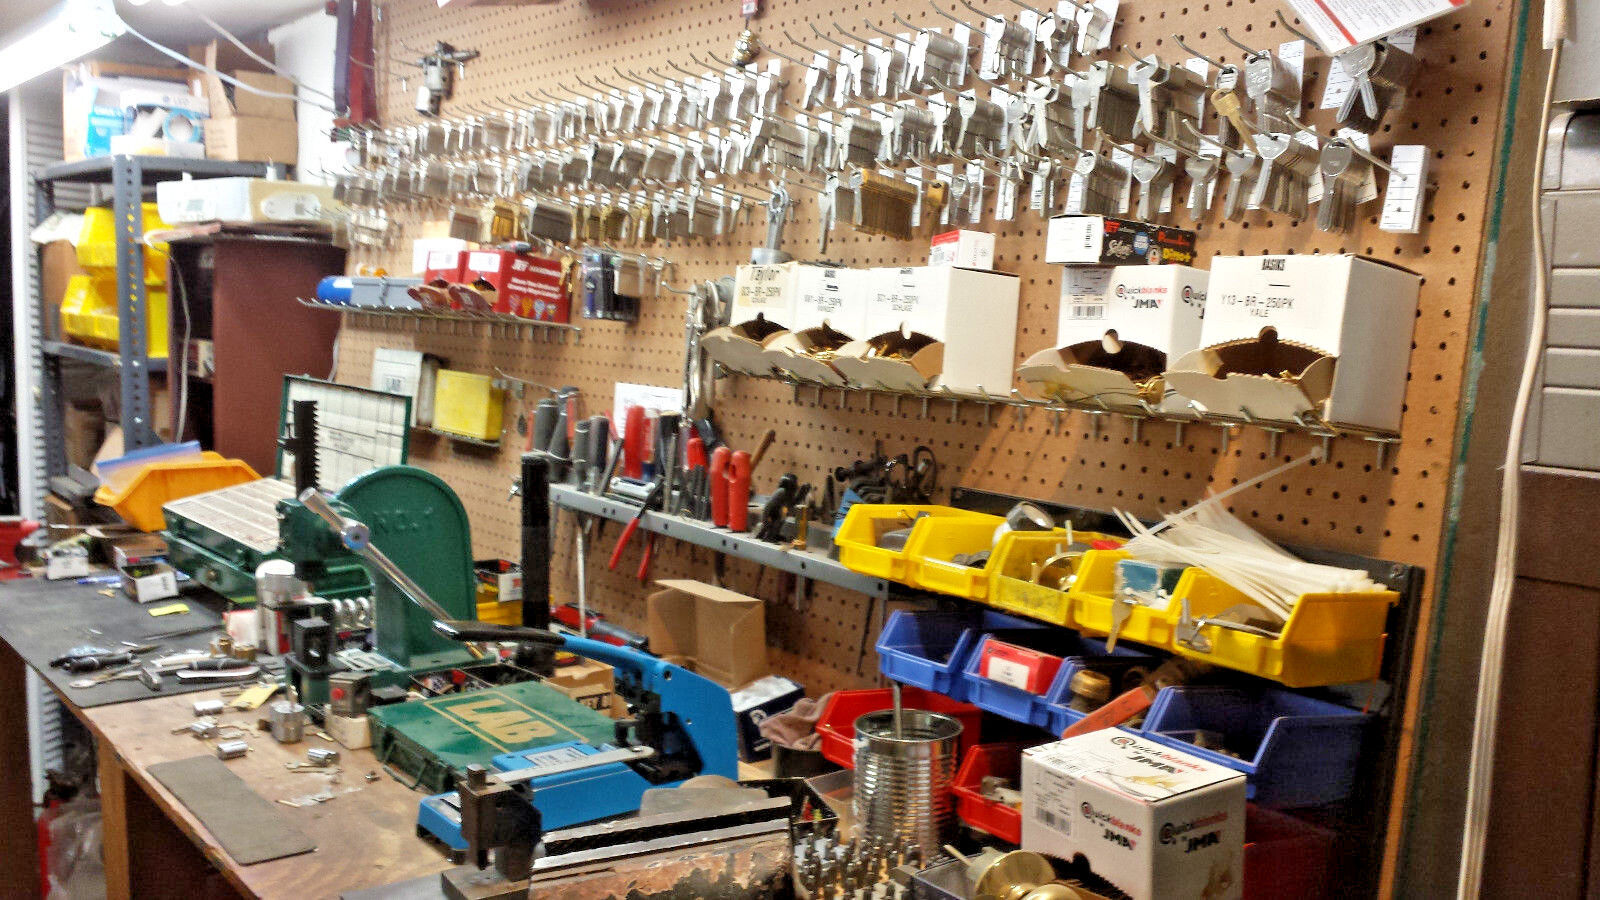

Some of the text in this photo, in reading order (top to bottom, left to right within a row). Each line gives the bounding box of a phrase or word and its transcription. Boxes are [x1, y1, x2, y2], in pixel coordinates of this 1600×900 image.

[1132, 299, 1160, 309] JMA
[446, 699, 557, 744] LAB
[1127, 755, 1178, 774] JMA
